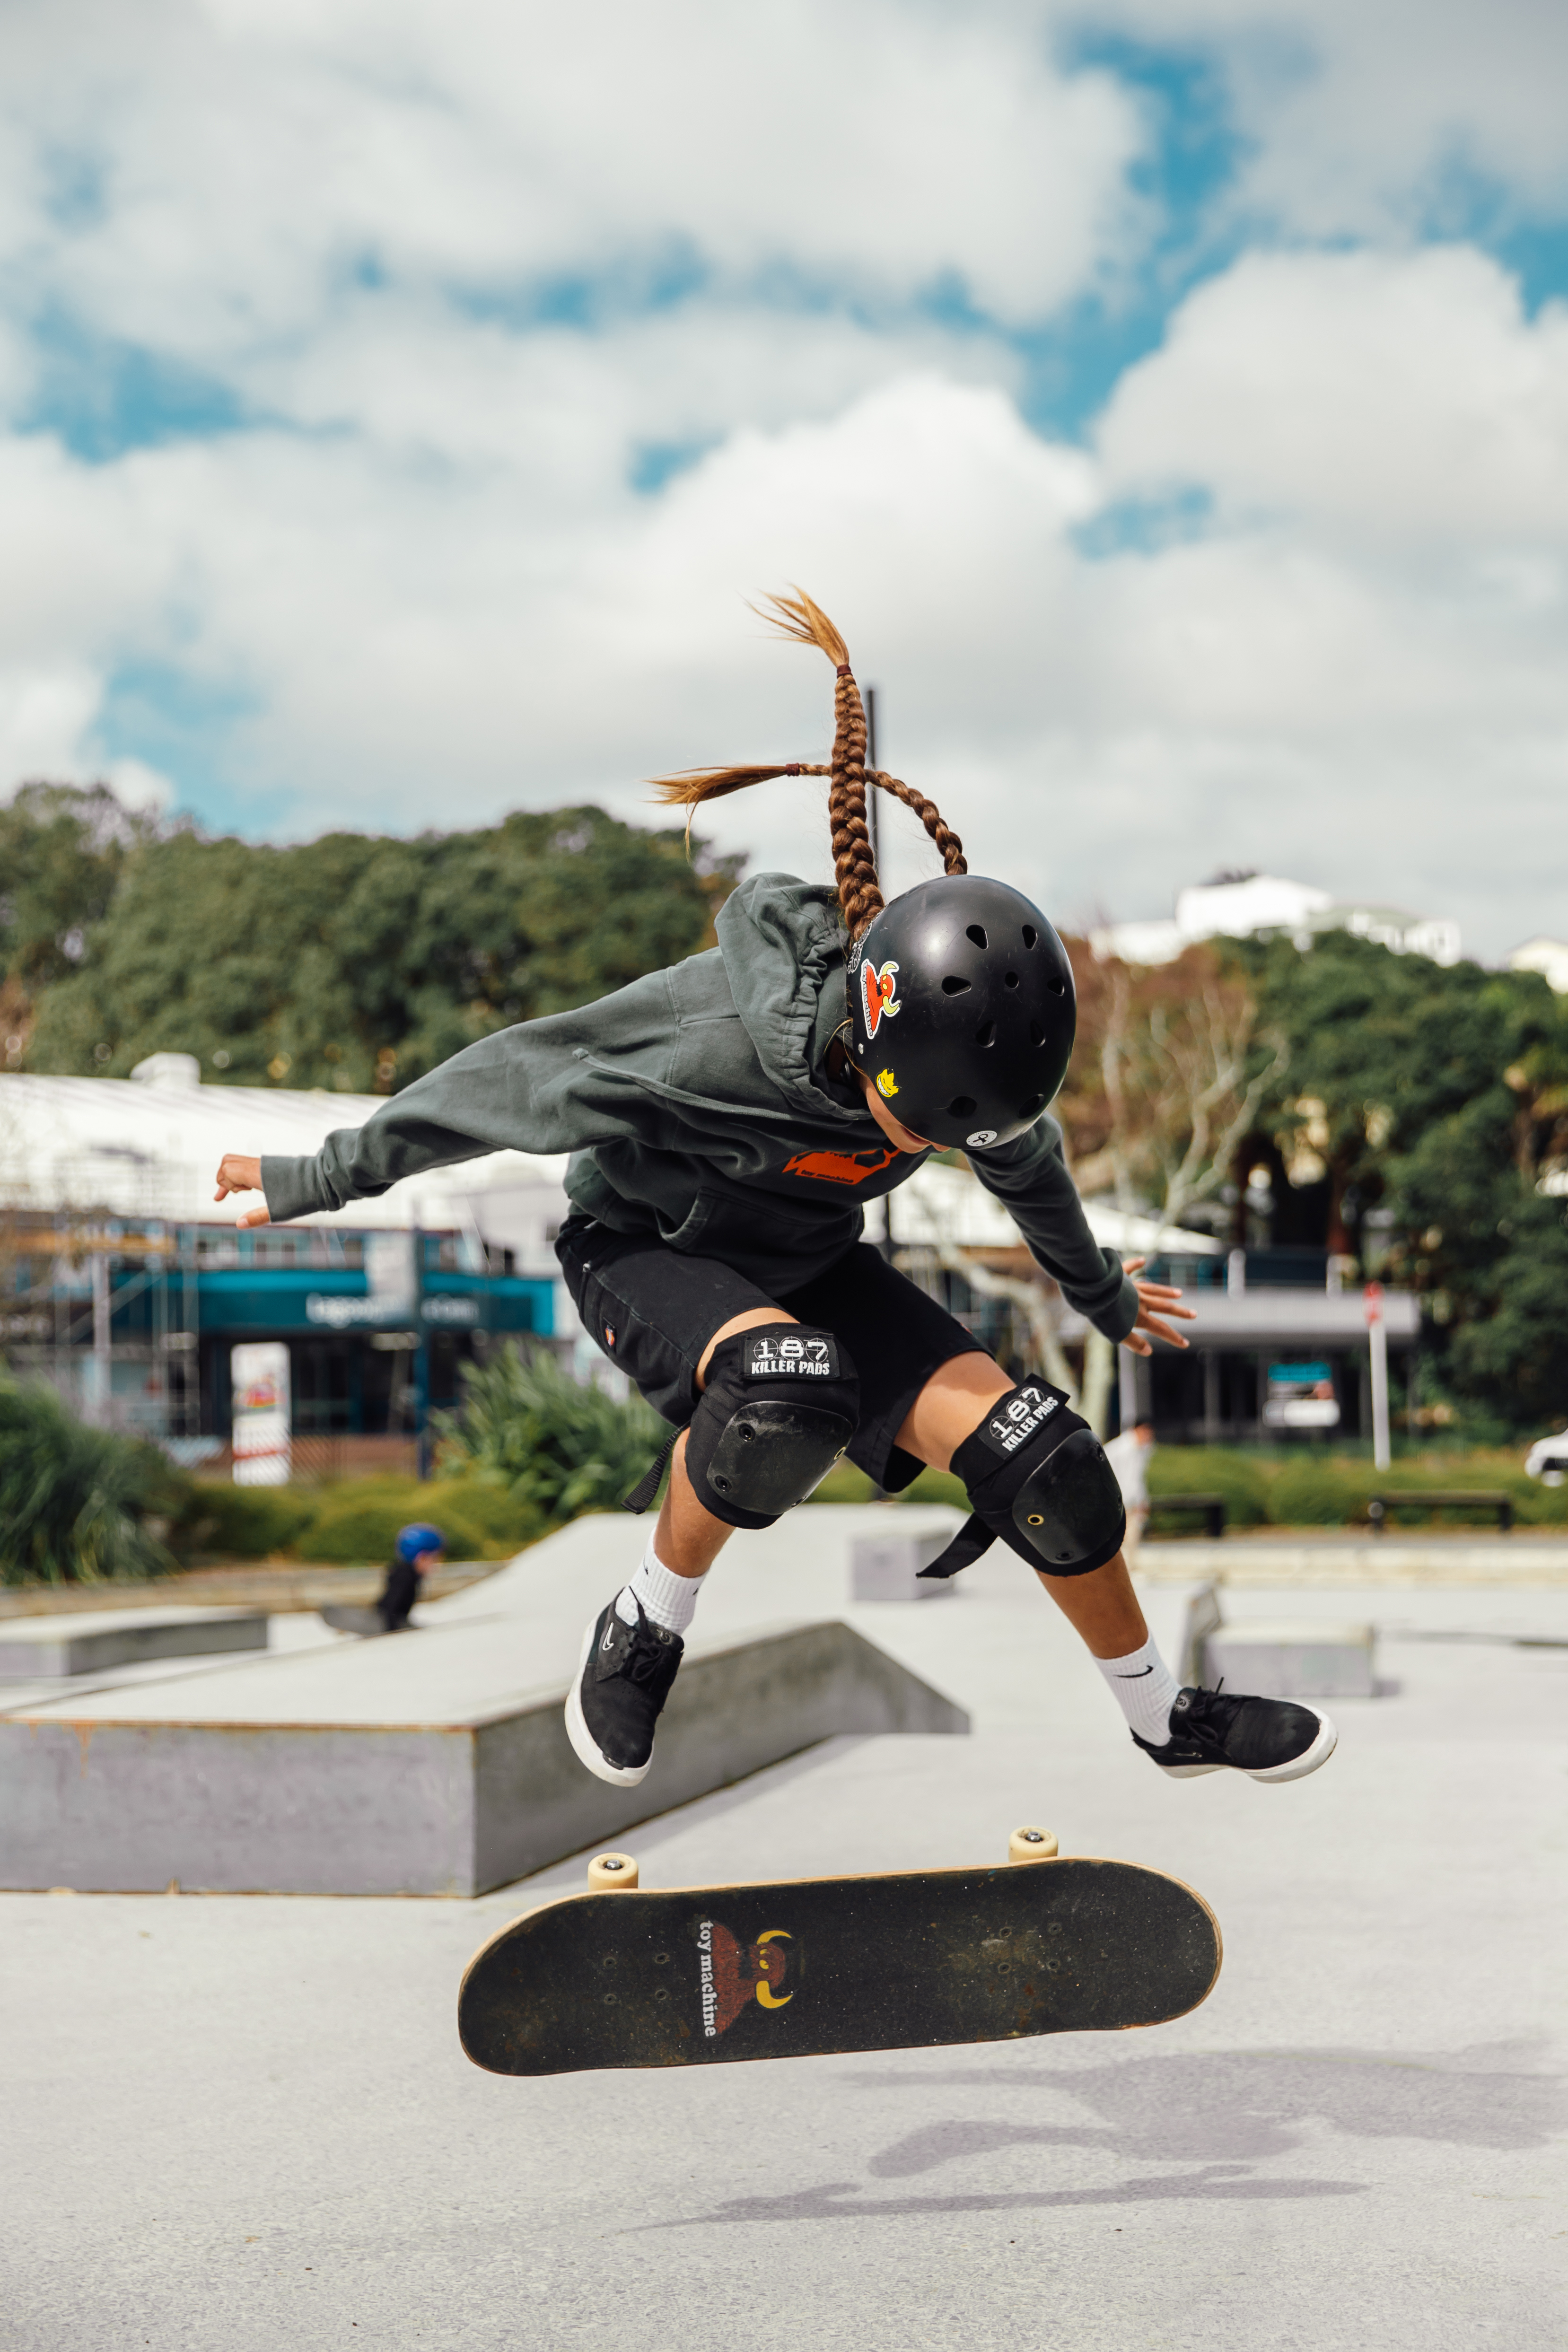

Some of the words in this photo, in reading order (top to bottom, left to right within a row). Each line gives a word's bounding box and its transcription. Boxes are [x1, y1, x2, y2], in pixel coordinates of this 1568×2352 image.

[863, 983, 873, 1036] machine
[752, 1360, 796, 1374] KILLER
[799, 1361, 830, 1375] PADS
[758, 1339, 828, 1360] 187
[992, 1387, 1041, 1438] 187
[1001, 1416, 1039, 1452] KILLER
[1033, 1396, 1059, 1420] PADS
[697, 1920, 714, 1952] toy
[700, 1954, 718, 2037] machine
